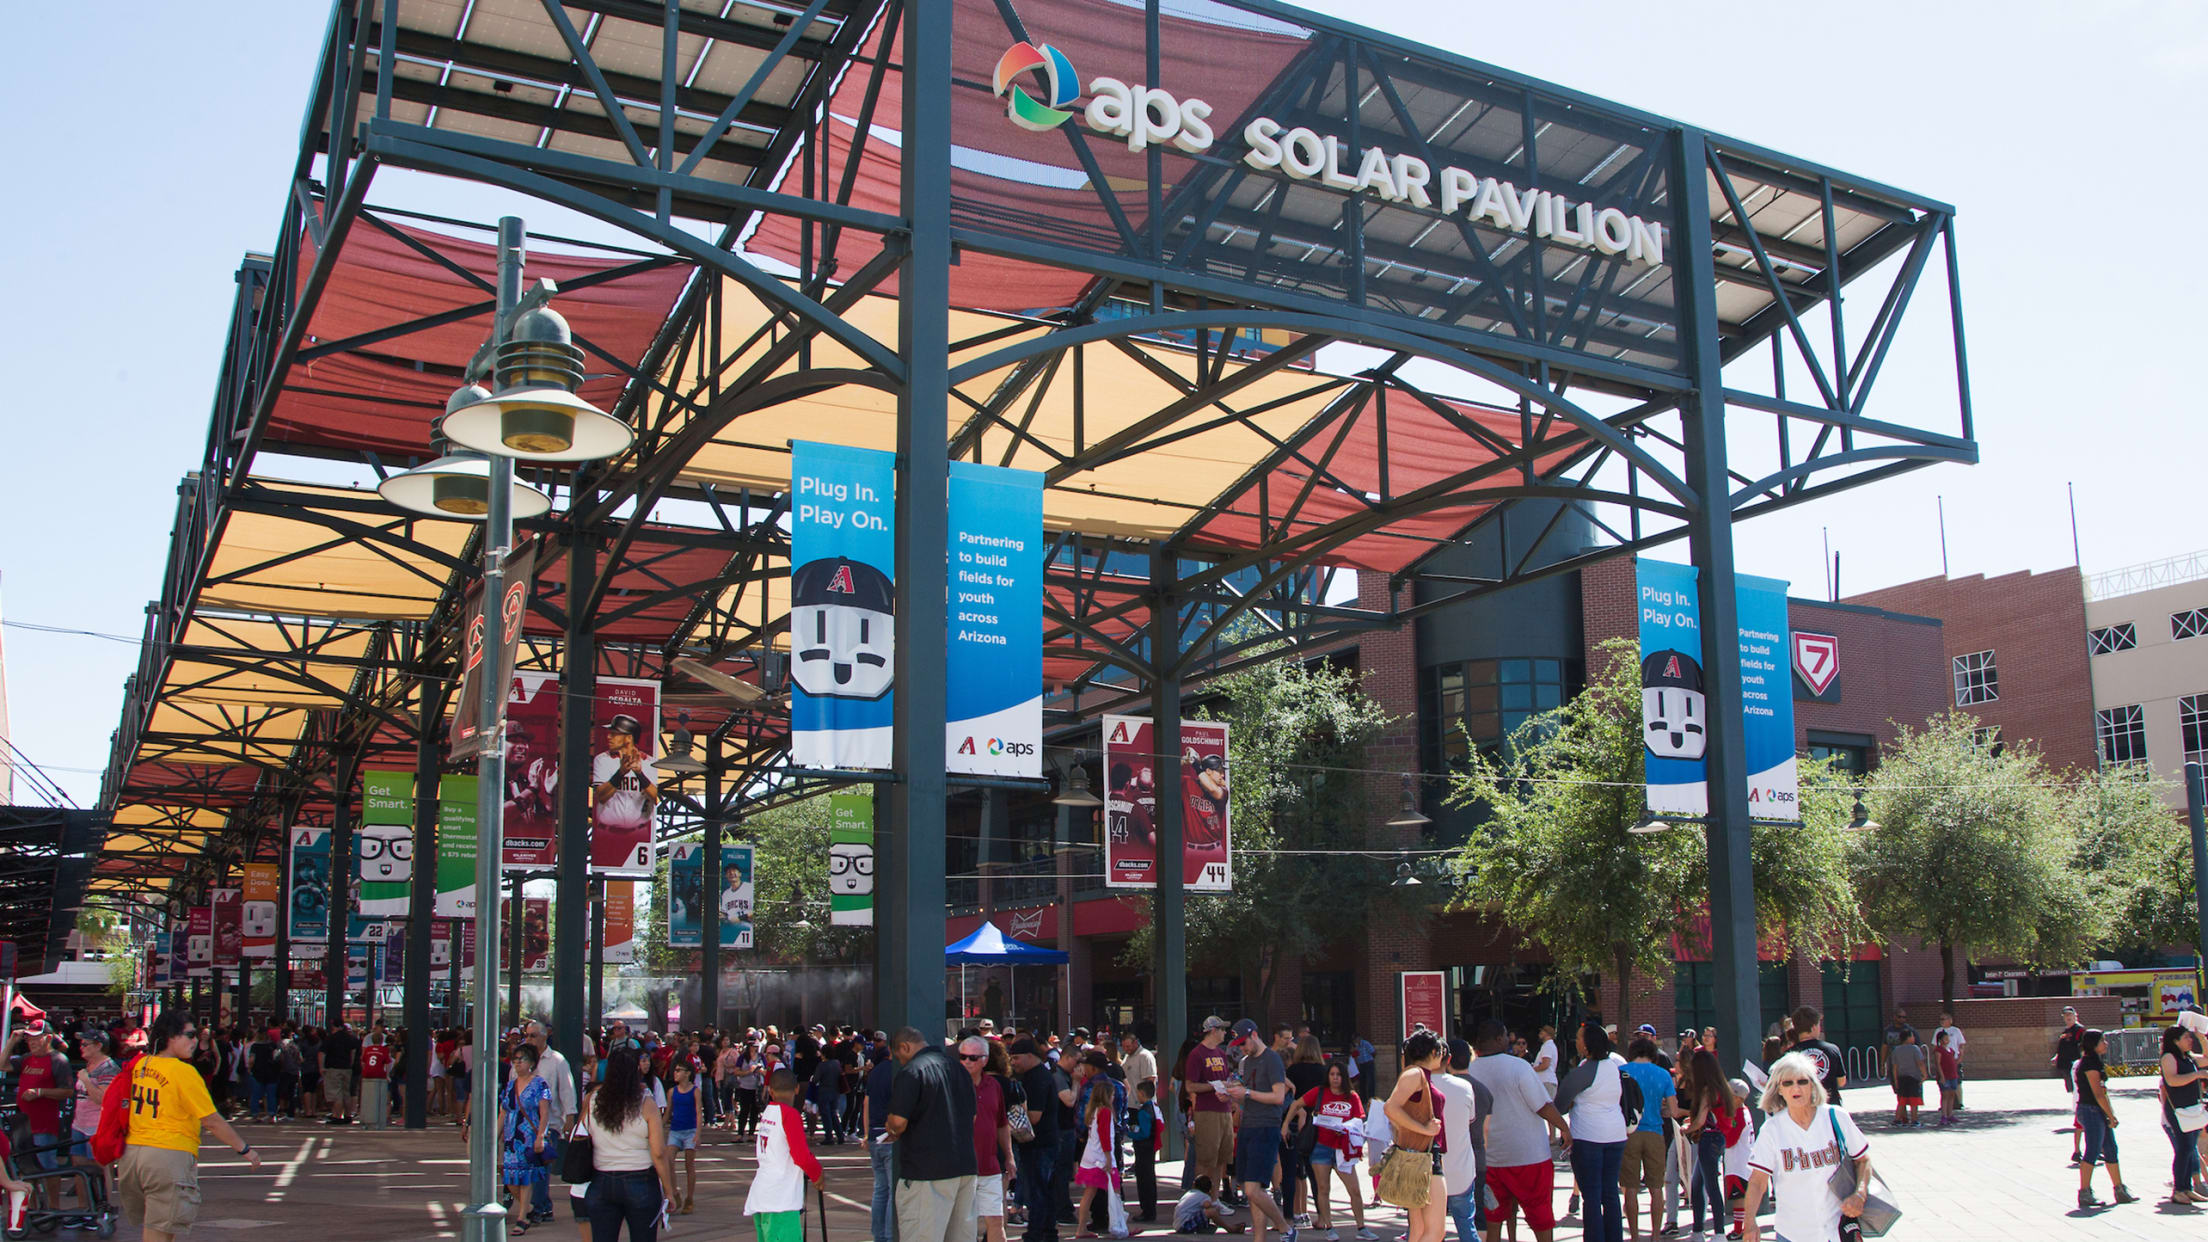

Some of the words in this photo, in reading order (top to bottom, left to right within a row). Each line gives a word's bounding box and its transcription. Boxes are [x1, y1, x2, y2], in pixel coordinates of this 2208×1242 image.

[1084, 76, 1214, 153] aps
[1243, 116, 1433, 208] SOLAR
[1440, 166, 1665, 265] PAVILION
[800, 476, 848, 502] Plug
[854, 482, 880, 502] In.
[800, 504, 846, 529] Play
[851, 510, 889, 531] On.
[959, 531, 1025, 552] Partnering
[959, 552, 973, 563] to
[975, 552, 1008, 568] build
[959, 570, 994, 586] fields
[996, 574, 1015, 588] for
[958, 589, 995, 606] youth
[1642, 586, 1672, 605] Plug
[1675, 592, 1691, 607] In.
[958, 611, 999, 625] across
[1643, 608, 1670, 628] Play
[1675, 613, 1698, 629] On.
[958, 629, 1008, 646] Arizona
[1739, 627, 1780, 644] Partnering
[1740, 643, 1749, 653] to
[1751, 644, 1770, 655] build
[1741, 659, 1763, 671] fields
[1764, 661, 1776, 672] for
[1805, 644, 1830, 675] 7
[1742, 674, 1765, 686] youth
[615, 688, 637, 697] DAVID
[1743, 690, 1768, 701] across
[608, 695, 642, 707] PERALTA
[1744, 705, 1774, 717] Arizona
[1181, 735, 1224, 747] GOLDSCHMIDT
[1006, 740, 1035, 757] aps
[369, 785, 391, 797] Get
[1777, 790, 1795, 802] aps
[368, 798, 409, 810] Smart.
[443, 815, 476, 824] qualifying
[835, 808, 854, 818] Get
[835, 819, 869, 831] Smart.
[637, 846, 649, 866] 6
[1206, 866, 1226, 883] 44
[368, 925, 383, 937] 22
[742, 932, 750, 944] 11
[369, 1055, 377, 1066] 6
[132, 1083, 161, 1119] 44
[1780, 1139, 1841, 1172] D-back
